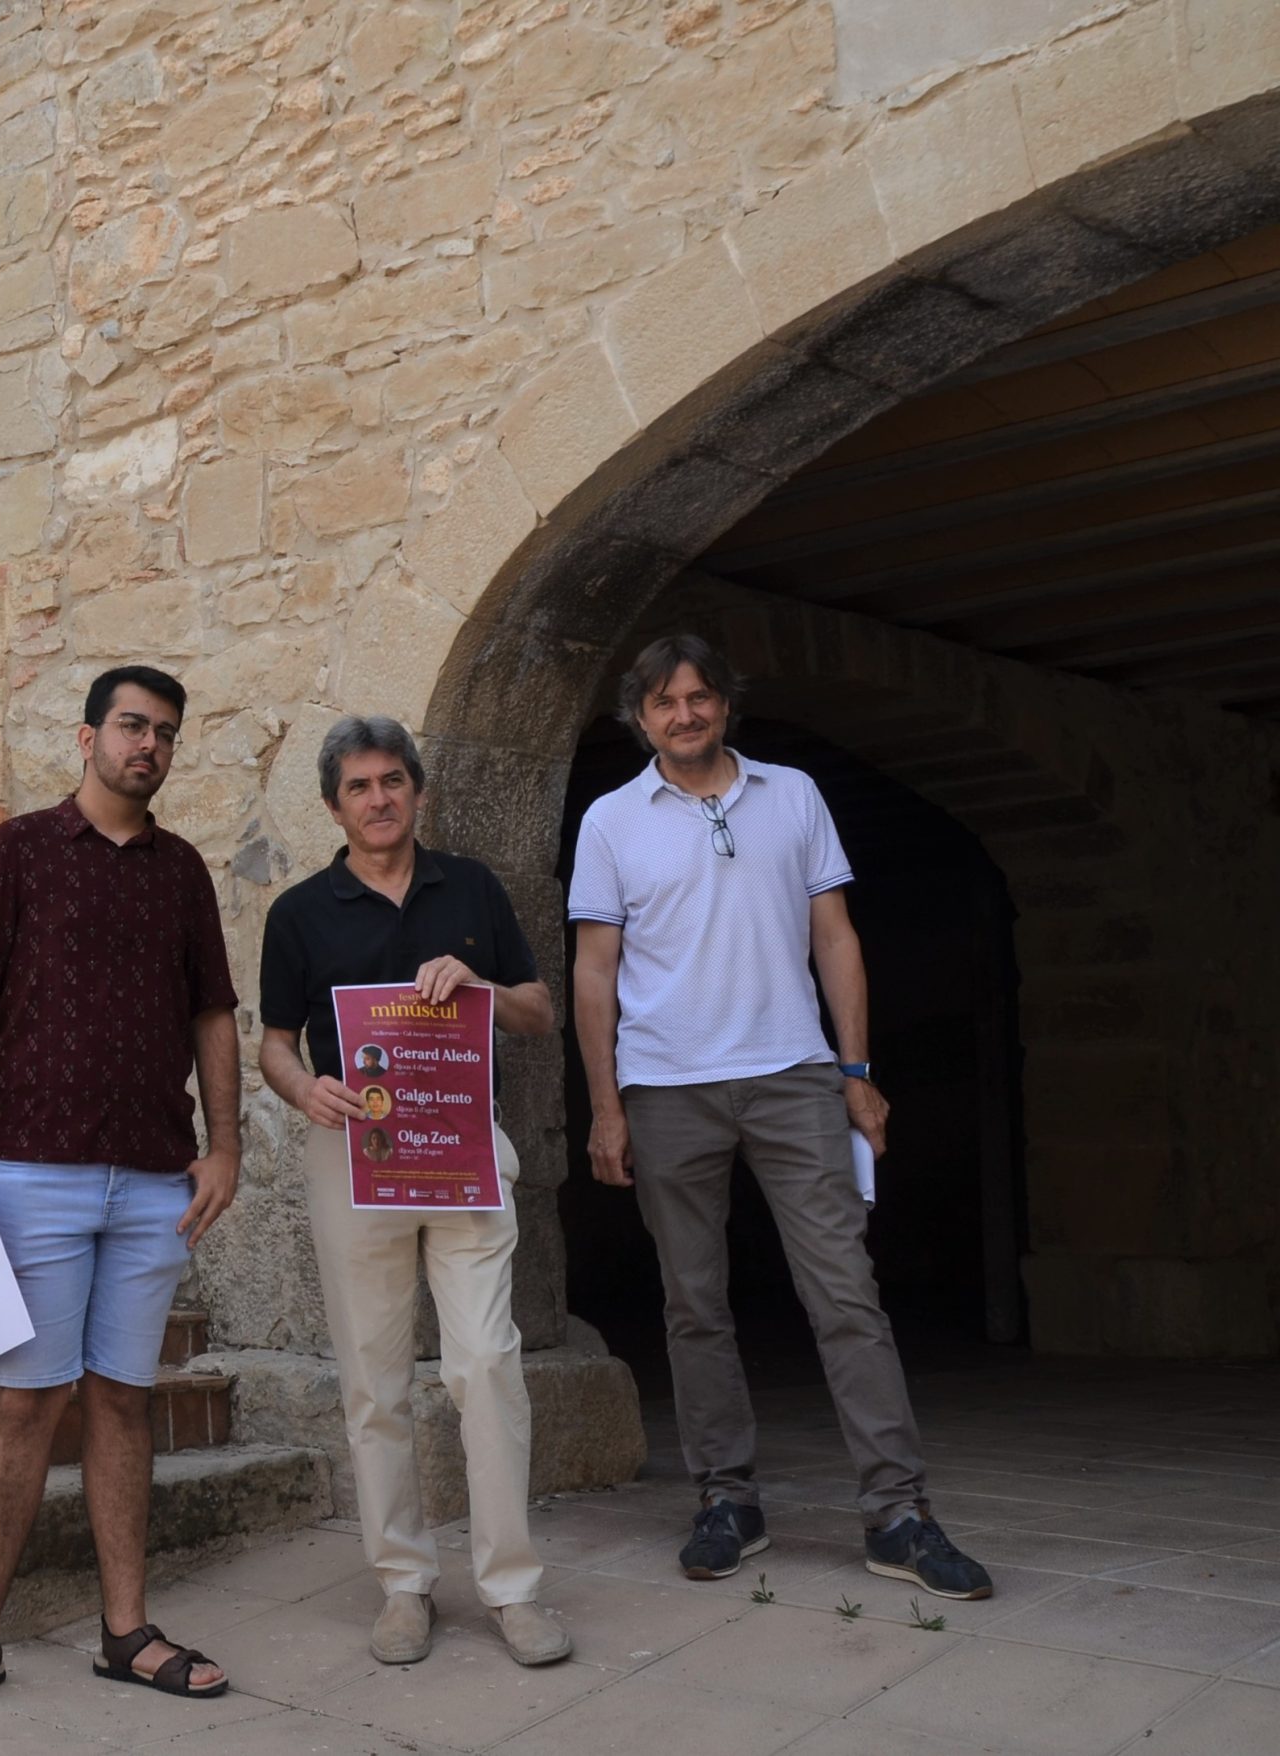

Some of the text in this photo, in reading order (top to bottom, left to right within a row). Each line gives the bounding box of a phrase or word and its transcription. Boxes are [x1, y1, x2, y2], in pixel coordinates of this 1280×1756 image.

[371, 1002, 458, 1019] minúscul
[392, 1046, 480, 1063] Gerard Aledo
[395, 1088, 472, 1105] Galgo Lento
[398, 1130, 461, 1147] Olga Zoet
